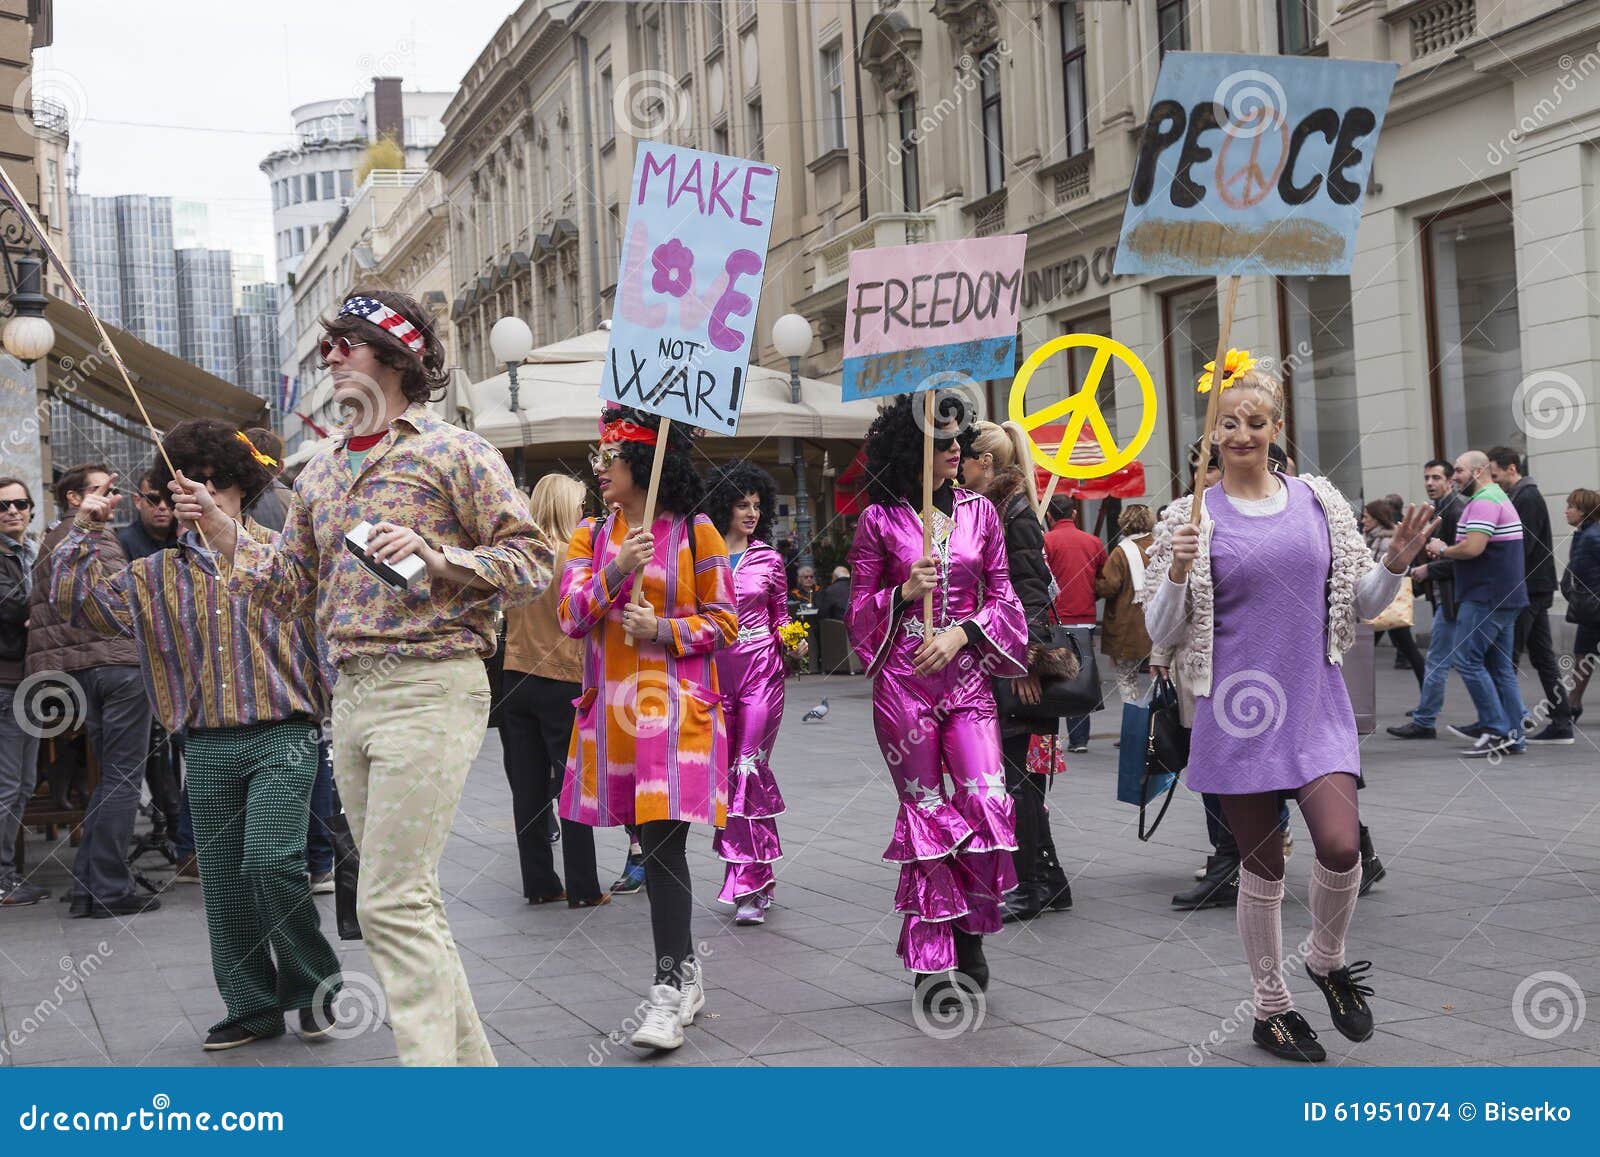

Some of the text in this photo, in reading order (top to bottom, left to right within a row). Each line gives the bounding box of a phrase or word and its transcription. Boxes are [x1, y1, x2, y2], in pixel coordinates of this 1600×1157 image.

[638, 151, 774, 226] MAKE
[851, 268, 1021, 344] FREEDOM
[1020, 254, 1089, 308] UNITED
[612, 347, 742, 427] WAR!
[658, 337, 705, 362] NOT
